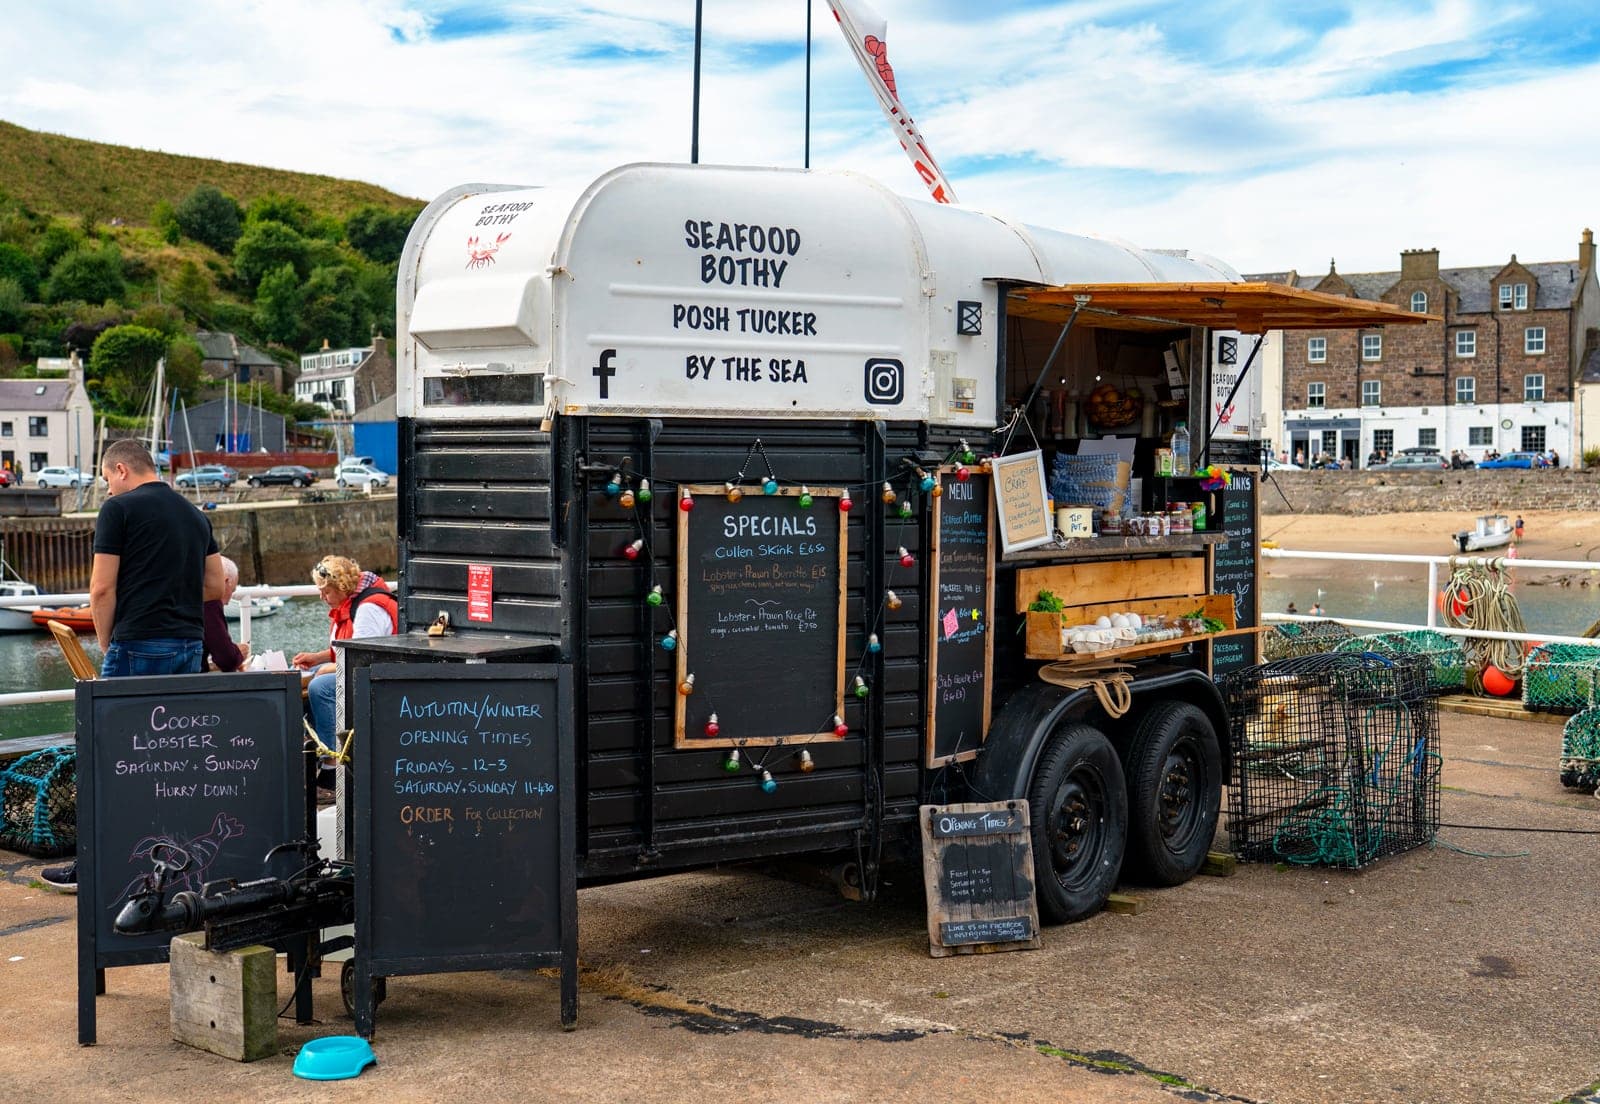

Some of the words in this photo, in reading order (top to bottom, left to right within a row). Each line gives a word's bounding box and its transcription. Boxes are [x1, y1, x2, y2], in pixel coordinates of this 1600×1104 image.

[481, 202, 534, 215] SEAFOOD
[475, 213, 519, 227] BOTHY
[685, 219, 801, 256] SEAFOOD
[701, 255, 788, 288] BOTHY
[673, 303, 730, 332] POSH
[737, 308, 817, 337] TUCKER
[686, 355, 716, 382] BY
[722, 356, 762, 382] THE
[769, 358, 808, 384] SEA
[948, 483, 973, 500] MENU
[723, 514, 817, 538] SPECIALS
[1069, 513, 1082, 522] TIP
[1071, 523, 1083, 533] POT
[715, 546, 753, 559] Cullen
[703, 568, 737, 582] Lobster
[745, 564, 769, 579] Prawn
[718, 611, 751, 623] Lobster
[759, 607, 783, 621] Prawn
[785, 609, 803, 621] Rice
[804, 608, 818, 621] Pot
[399, 730, 469, 746] OPENING
[400, 805, 455, 824] ORDER
